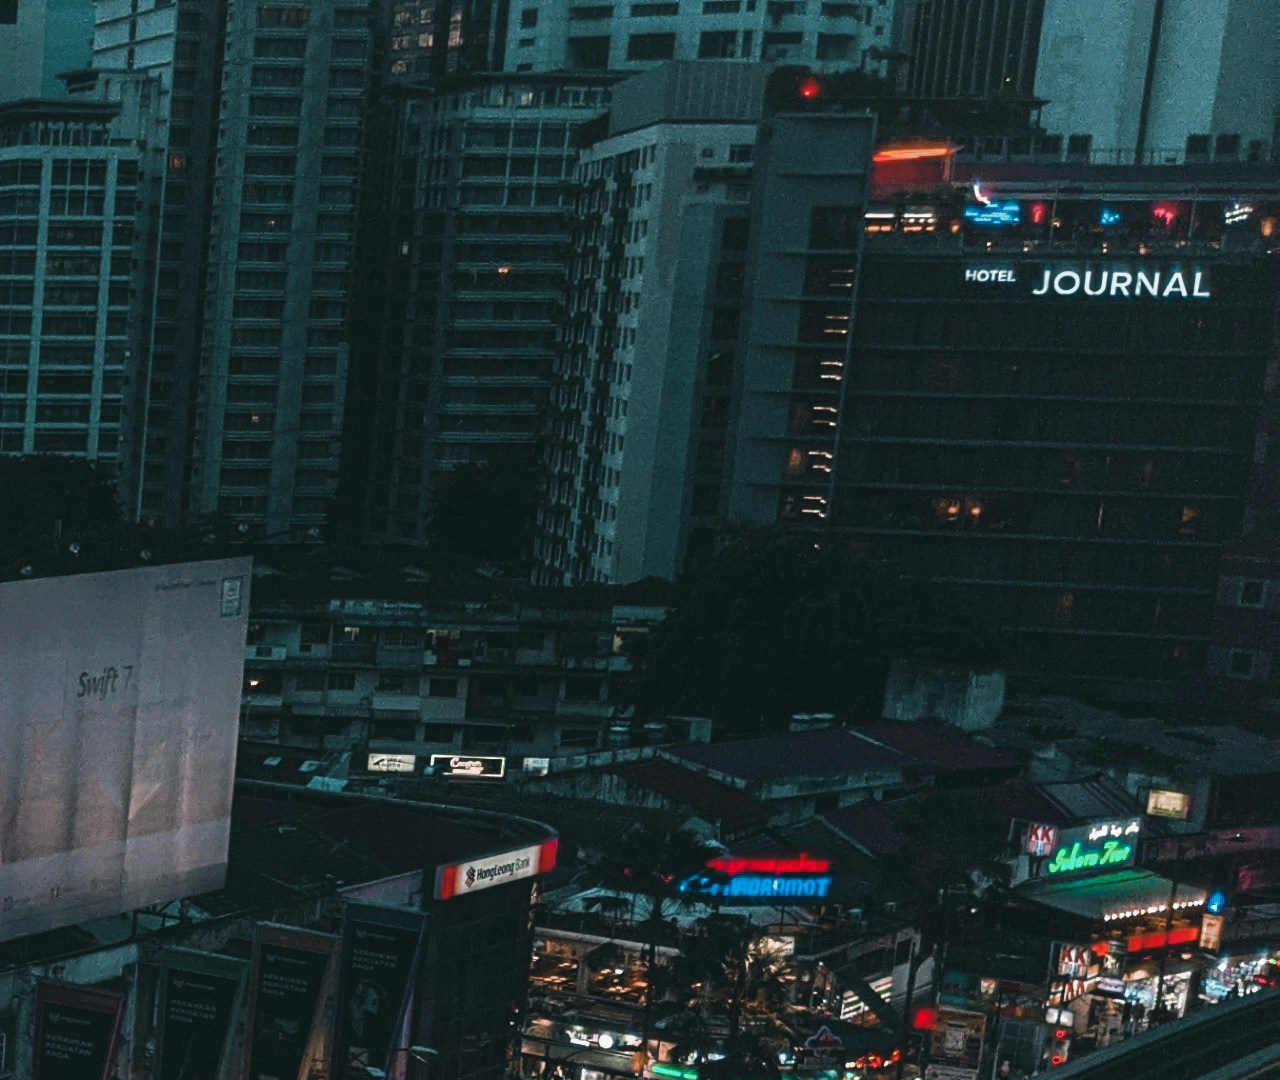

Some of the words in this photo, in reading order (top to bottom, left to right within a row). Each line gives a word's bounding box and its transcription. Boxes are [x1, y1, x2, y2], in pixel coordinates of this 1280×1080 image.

[965, 269, 1016, 283] HOTEL
[1032, 270, 1211, 298] JOURNAL
[77, 666, 118, 700] Swift
